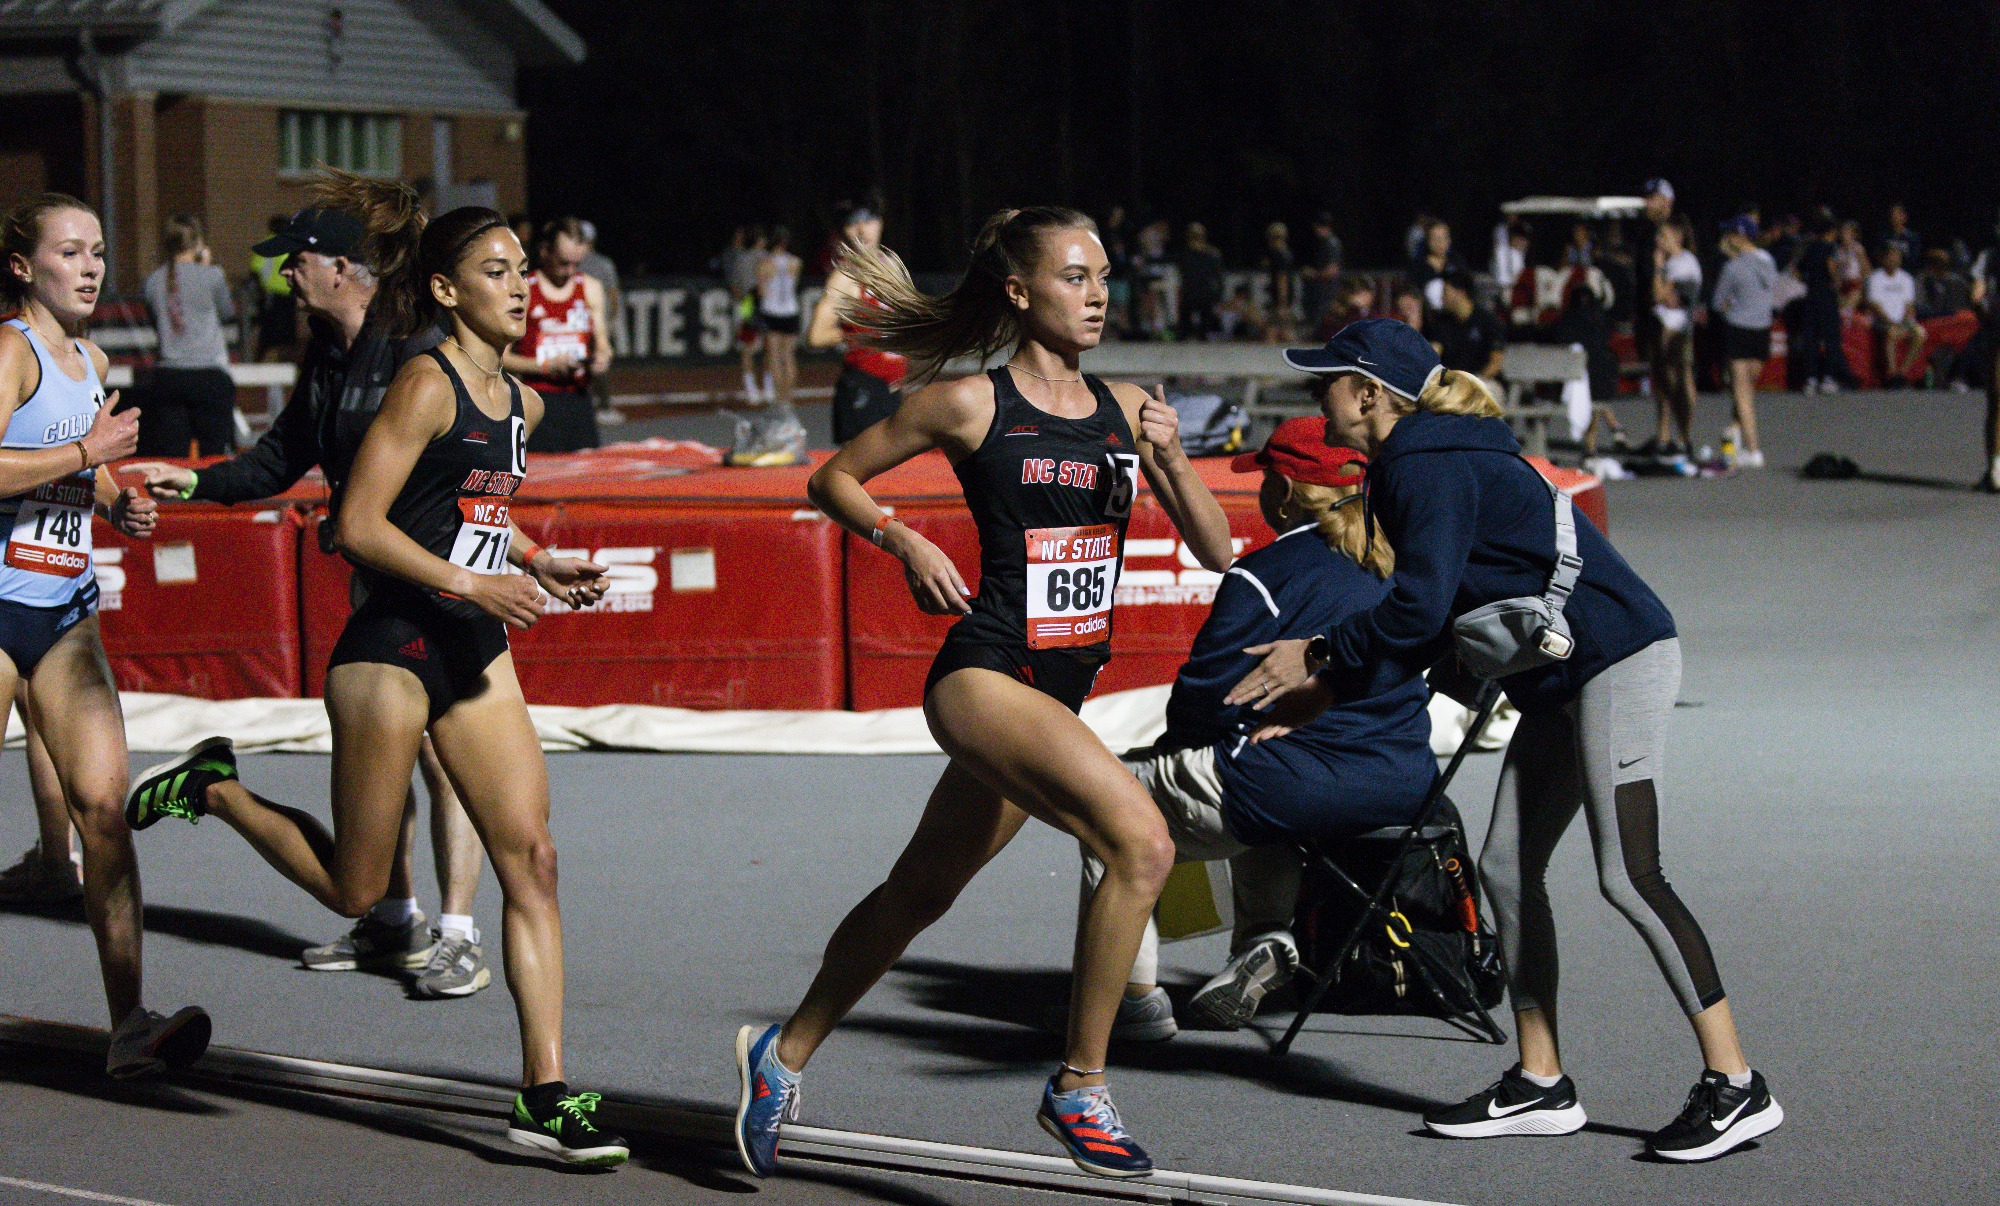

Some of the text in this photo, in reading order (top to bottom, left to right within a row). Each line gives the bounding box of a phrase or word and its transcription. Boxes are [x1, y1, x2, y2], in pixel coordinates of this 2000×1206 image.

[466, 431, 489, 441] ACC
[1008, 425, 1040, 435] ACC
[515, 422, 527, 474] 6
[461, 469, 491, 492] NC
[1021, 458, 1100, 490] NC STA
[1111, 458, 1134, 513] 5
[35, 484, 88, 505] NC STATE
[474, 504, 495, 523] NC
[33, 507, 82, 547] 148
[465, 530, 510, 570] 711
[1041, 534, 1112, 561] NC STATE
[46, 552, 87, 570] adidas
[1046, 565, 1107, 612] 685
[1074, 616, 1107, 635] adidas
